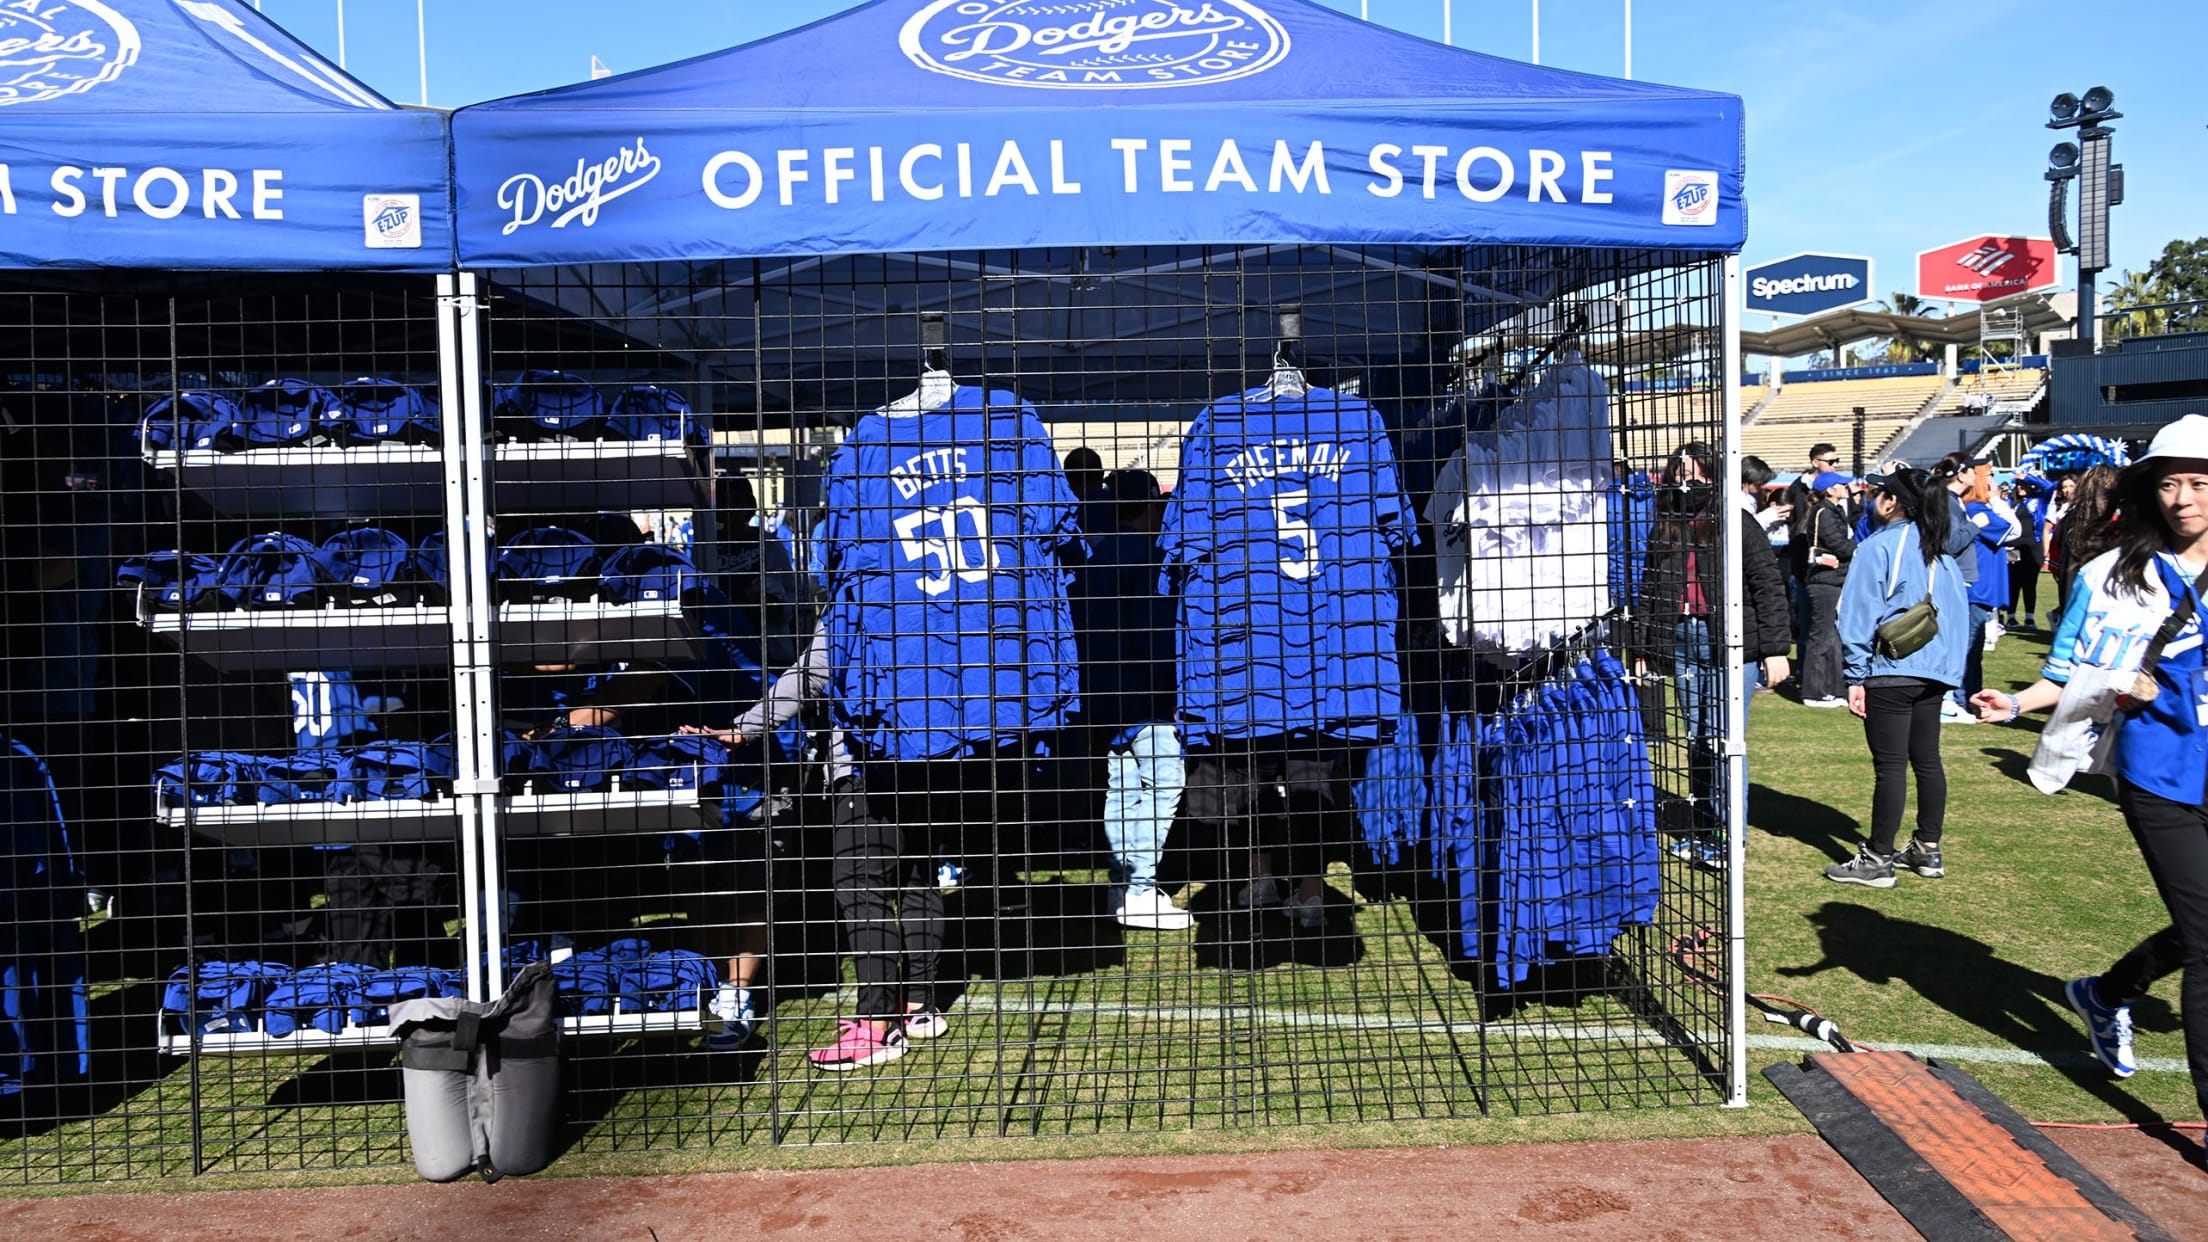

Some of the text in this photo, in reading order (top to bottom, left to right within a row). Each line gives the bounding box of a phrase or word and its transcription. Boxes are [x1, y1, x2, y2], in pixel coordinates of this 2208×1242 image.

[940, 2, 1245, 62] Dodgers
[979, 39, 1260, 83] TEAM STORE
[51, 165, 284, 220] STORE
[497, 136, 661, 236] Dodgers
[702, 138, 1615, 210] OFFICIAL TEAM STORE
[1752, 273, 1853, 300] Spectrum
[1944, 279, 2026, 292] BANK OF AMERICA
[1822, 369, 1860, 378] SINCE
[890, 447, 967, 500] BETTS
[1224, 439, 1351, 494] FREEMAN
[893, 495, 1001, 597] 50
[1270, 489, 1320, 580] 5
